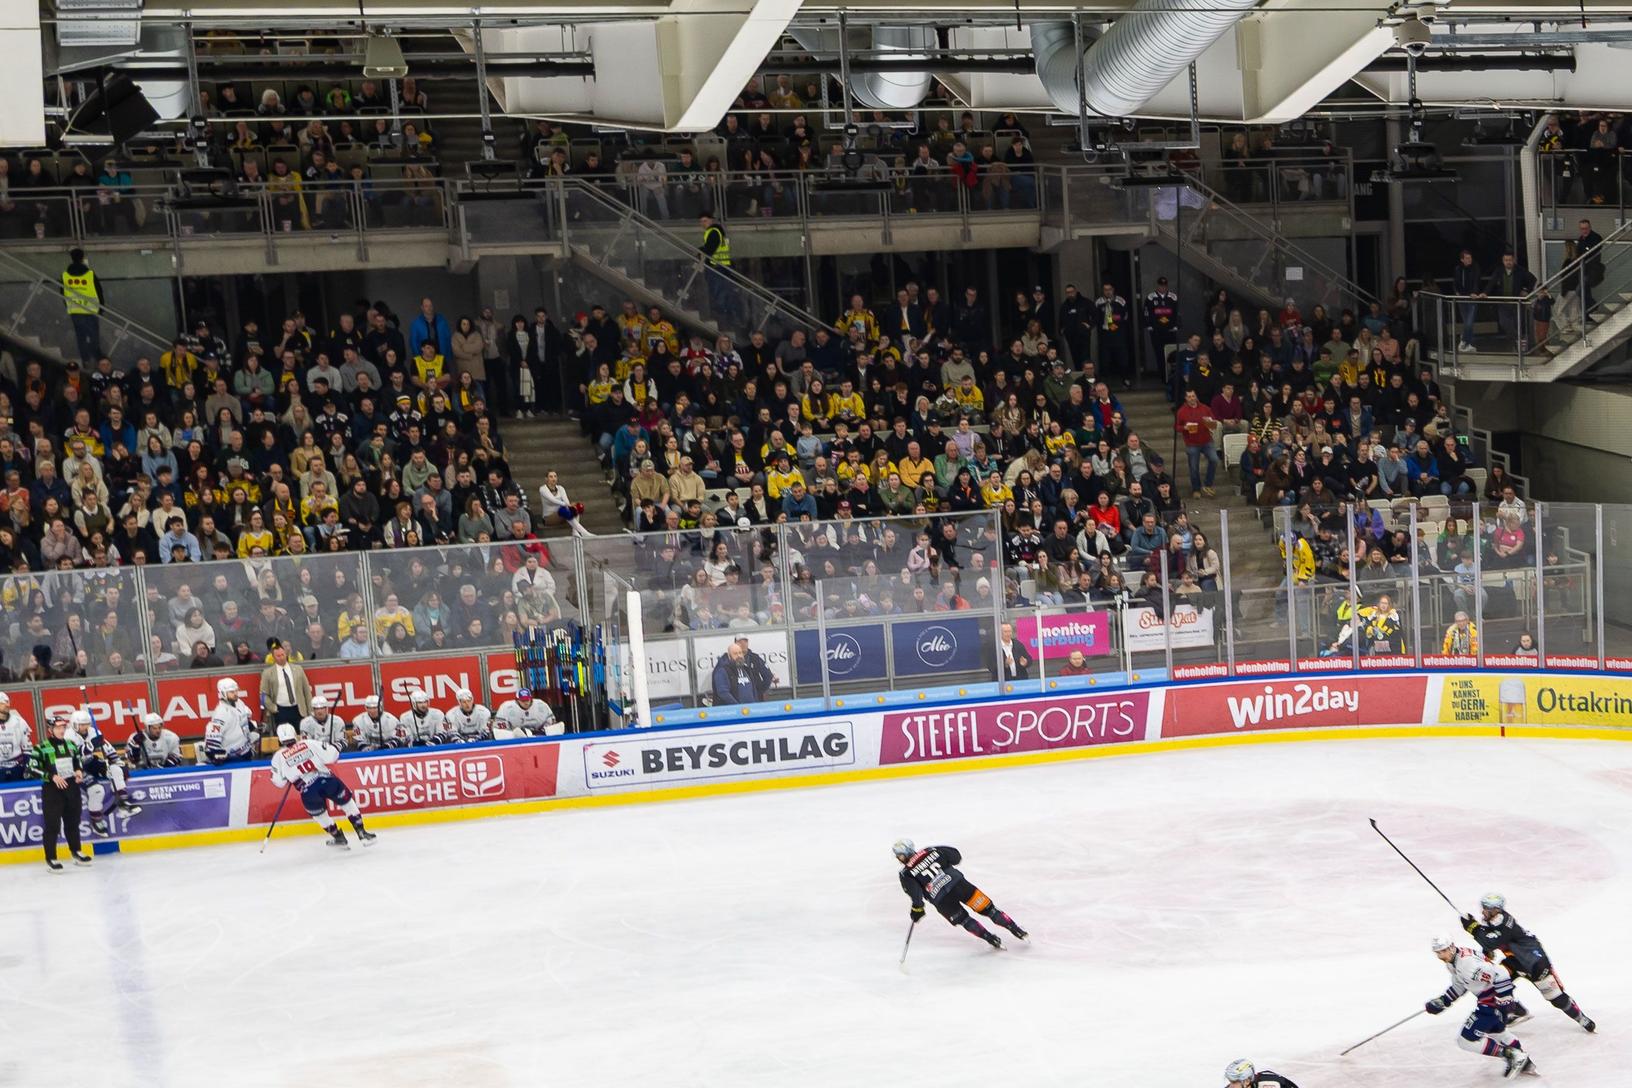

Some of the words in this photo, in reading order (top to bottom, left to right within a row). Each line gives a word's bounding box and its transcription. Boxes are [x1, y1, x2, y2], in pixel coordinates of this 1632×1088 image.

[1227, 684, 1359, 729] win2day
[902, 711, 983, 759] STEFFL
[992, 701, 1135, 747] SPORTS
[355, 759, 457, 786] WIENER
[591, 768, 635, 780] SUZUKI
[641, 732, 849, 774] BEYSCHLAG
